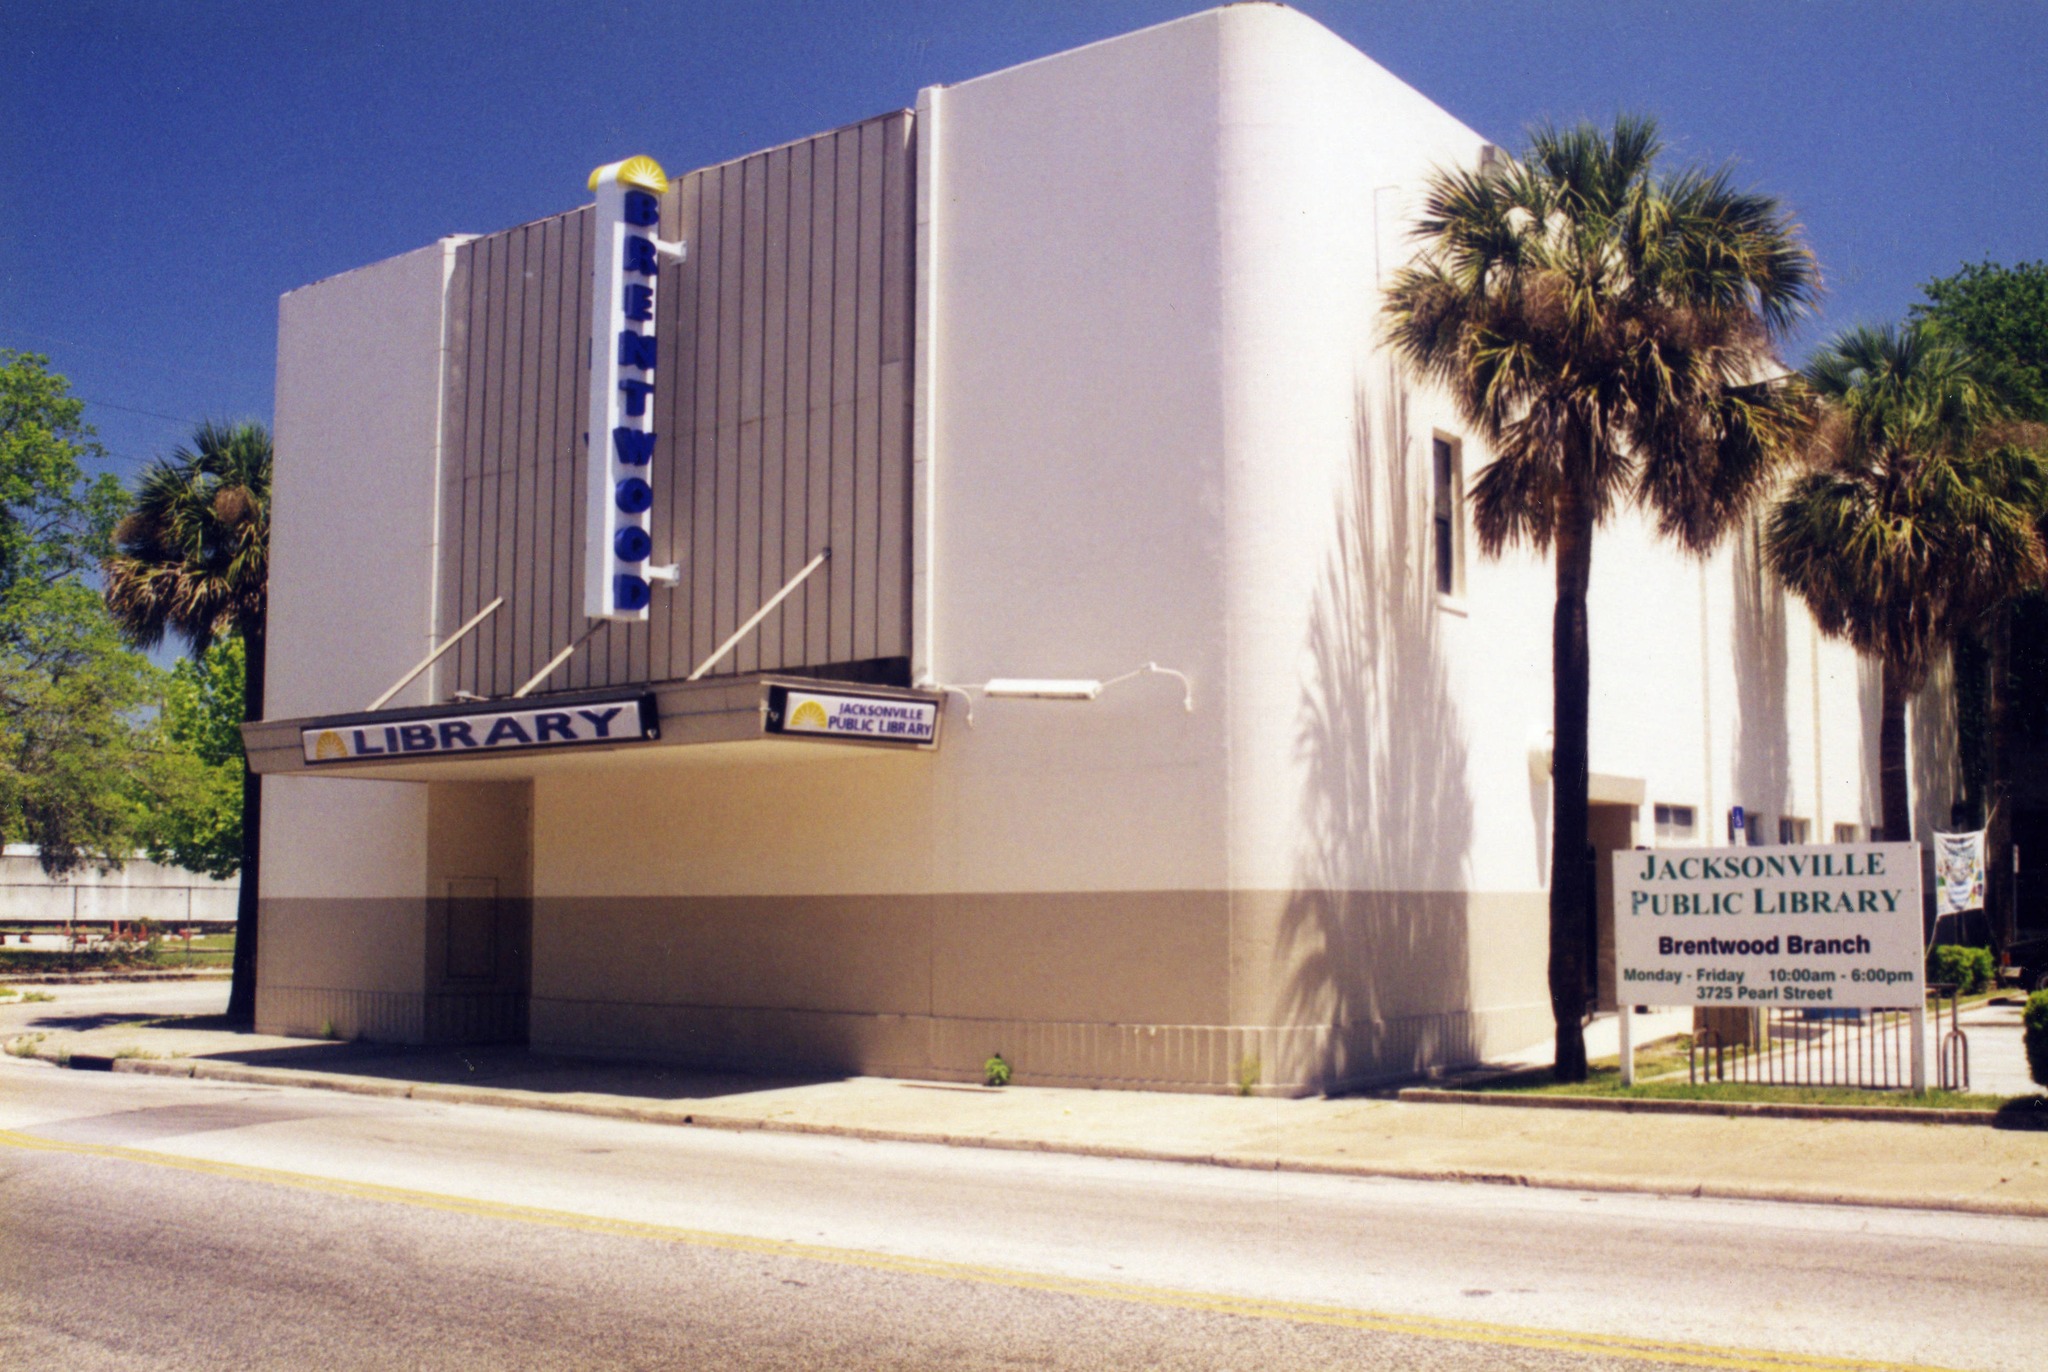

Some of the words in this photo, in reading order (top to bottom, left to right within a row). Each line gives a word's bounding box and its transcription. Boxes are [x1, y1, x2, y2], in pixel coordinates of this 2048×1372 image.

[612, 190, 658, 610] BRENTWOOD
[839, 703, 923, 720] JACKSONVILLE
[353, 706, 622, 756] LIBRARY
[828, 715, 873, 732] PUBLIC
[878, 720, 932, 736] LIBRARY
[1640, 853, 1886, 880] JACKSONVILLE
[1631, 890, 1743, 916] PUBLIC
[1753, 888, 1902, 914] LIBRARY
[1658, 936, 1780, 955] Brentwood
[1787, 935, 1871, 954] Branch
[1624, 968, 1682, 984] Monday
[1696, 967, 1745, 984] Friday
[1768, 968, 1836, 983] 10:00am
[1851, 968, 1914, 985] 6:00pm
[1696, 986, 1733, 1000] 3725
[1737, 986, 1779, 1000] Pearl
[1783, 986, 1833, 1000] Street
